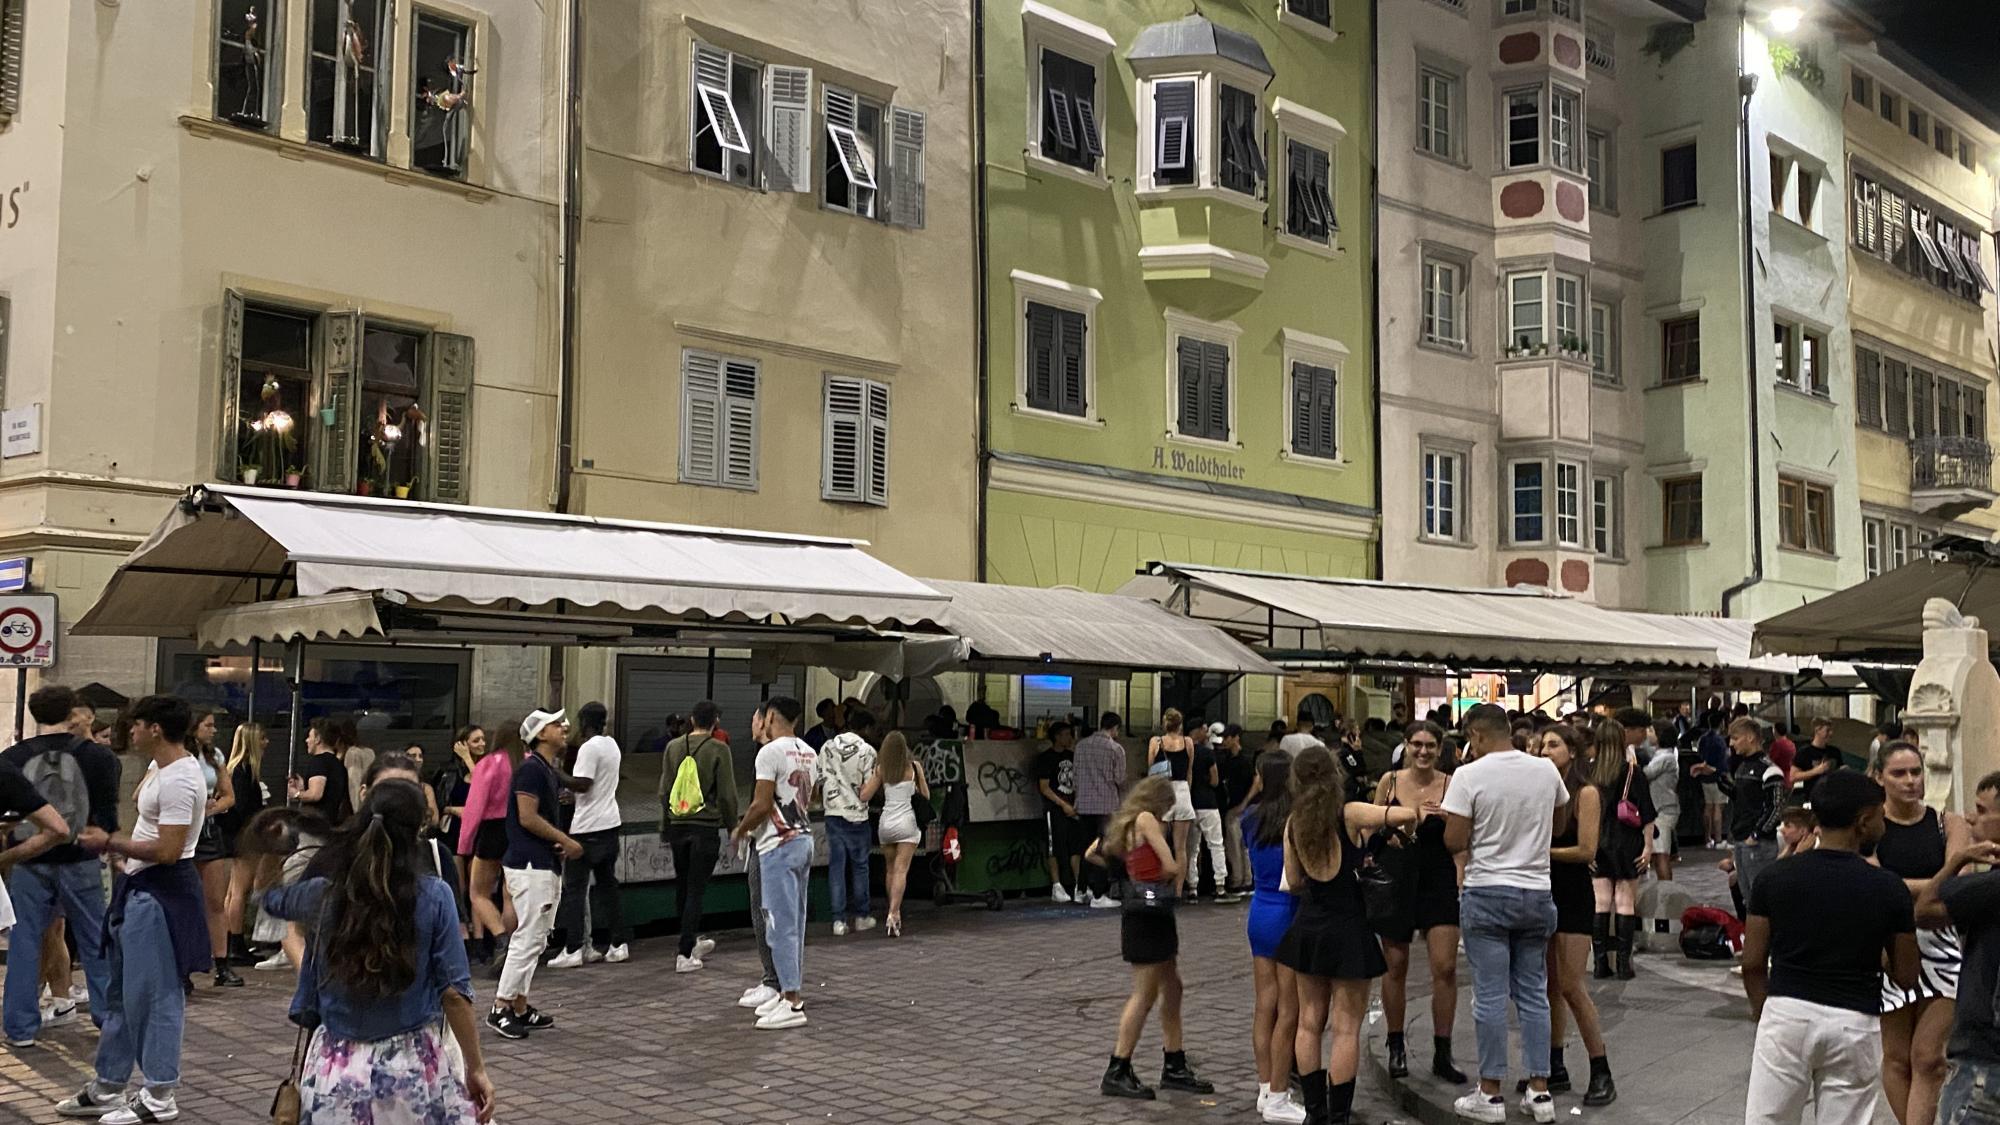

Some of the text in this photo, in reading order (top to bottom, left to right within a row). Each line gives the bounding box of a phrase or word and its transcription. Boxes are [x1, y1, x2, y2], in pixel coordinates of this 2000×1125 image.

[0, 181, 30, 229] S"
[1152, 446, 1246, 481] A. Waldthaler
